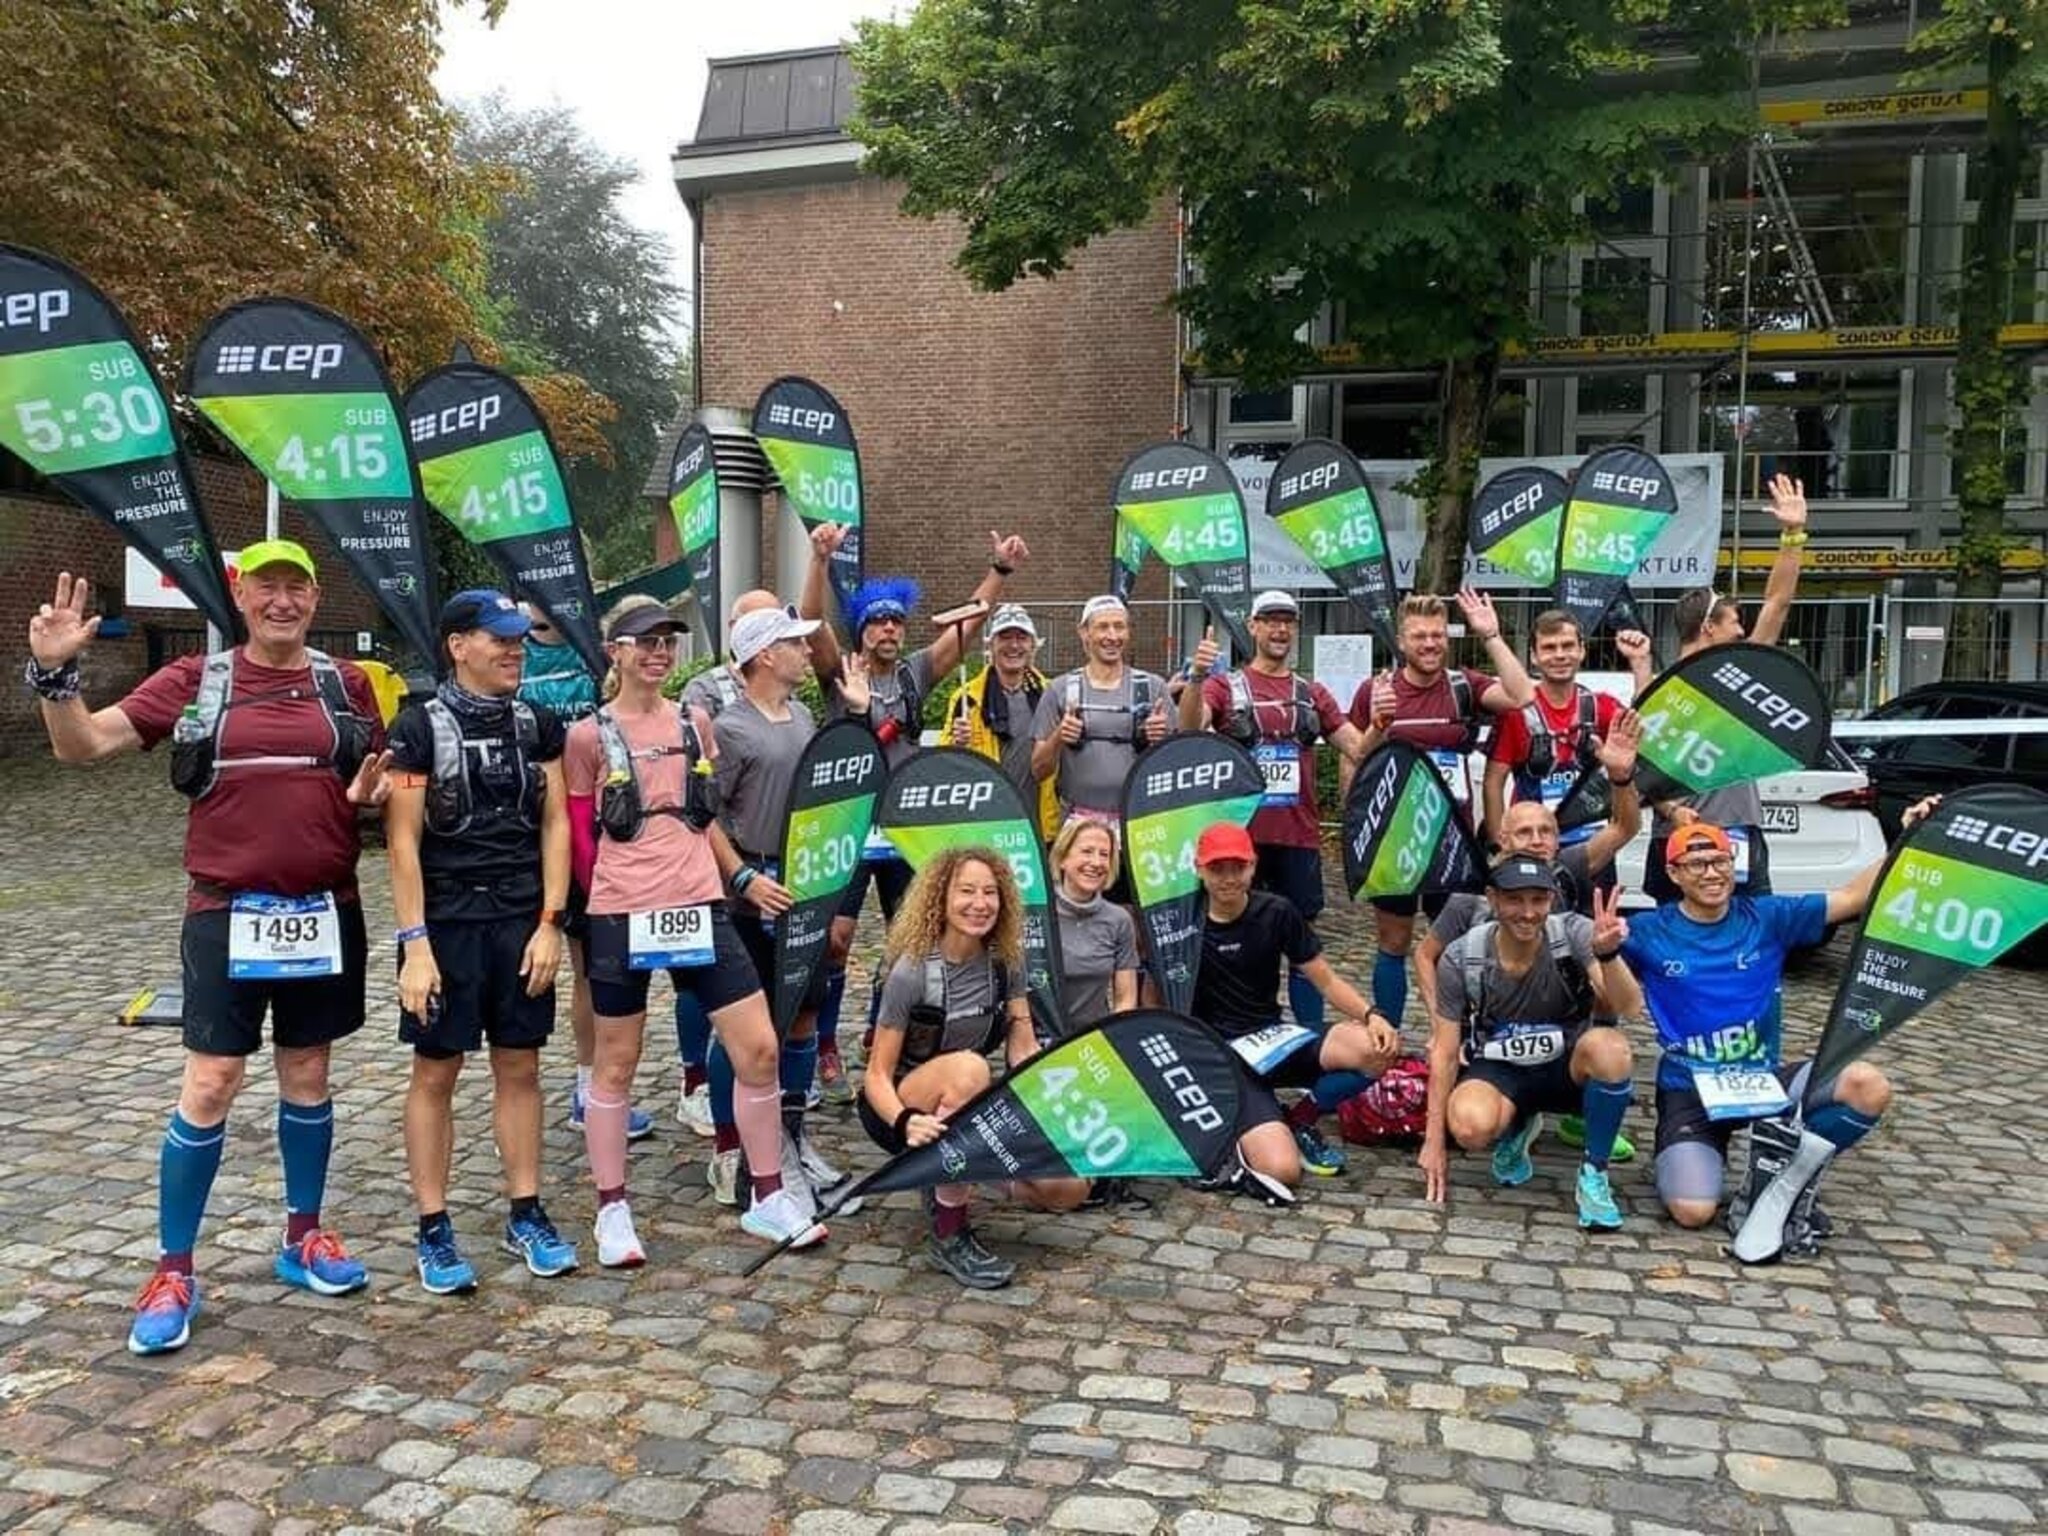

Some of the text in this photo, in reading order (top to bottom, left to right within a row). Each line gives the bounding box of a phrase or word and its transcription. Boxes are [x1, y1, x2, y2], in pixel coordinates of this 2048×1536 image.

[0, 289, 70, 332] ep
[1536, 335, 1587, 351] ondor
[88, 357, 137, 381] SUB
[259, 344, 343, 379] cep
[15, 385, 161, 452] 5:30
[344, 408, 387, 426] SUB
[440, 394, 500, 433] cep
[792, 408, 836, 436] cep
[275, 433, 388, 481] 4:15
[509, 446, 544, 468] SUB
[683, 444, 704, 475] cep
[131, 469, 177, 490] ENJOY
[155, 483, 183, 499] THE
[1157, 465, 1208, 490] cep
[1300, 461, 1340, 491] cep
[1615, 474, 1660, 501] cep
[460, 470, 548, 525] 4:15
[800, 472, 858, 512] 5:00
[1501, 482, 1543, 520] cep
[114, 498, 188, 522] PRESSURE
[363, 509, 408, 523] ENJOY
[341, 536, 411, 549] PRESSURE
[383, 523, 410, 535] THE
[1161, 517, 1239, 555] 4:45
[1309, 514, 1374, 559] 3:45
[1572, 525, 1636, 563] 3:45
[533, 539, 570, 556] ENJOY
[552, 553, 573, 565] THE
[517, 565, 576, 582] PRESSURE
[1665, 690, 1697, 716] SUB
[1740, 682, 1811, 732] cep
[1640, 709, 1725, 777] 4:15
[833, 753, 874, 784] cep
[1176, 760, 1234, 790] cep
[930, 781, 993, 811] cep
[1367, 755, 1397, 830] cep
[991, 832, 1028, 848] SUB
[1135, 825, 1168, 847] SUB
[1397, 781, 1441, 884] 3:00
[793, 833, 856, 886] 3:30
[1139, 839, 1196, 887] 3:4
[1903, 863, 1943, 887] SUB
[249, 916, 319, 942] 1493
[645, 909, 701, 936] 1899
[1883, 887, 2004, 950] 4:00
[1861, 960, 1888, 977] THE
[1865, 949, 1909, 970] ENJOY
[1856, 972, 1928, 1001] PRESSURE
[1500, 1034, 1554, 1058] 1979
[1078, 1045, 1111, 1087] SUB
[1161, 1065, 1224, 1132] cep
[982, 1106, 1004, 1133] THE
[993, 1099, 1027, 1137] ENJOY
[1038, 1065, 1129, 1169] 4:30
[970, 1115, 1021, 1175] PRESSURE
